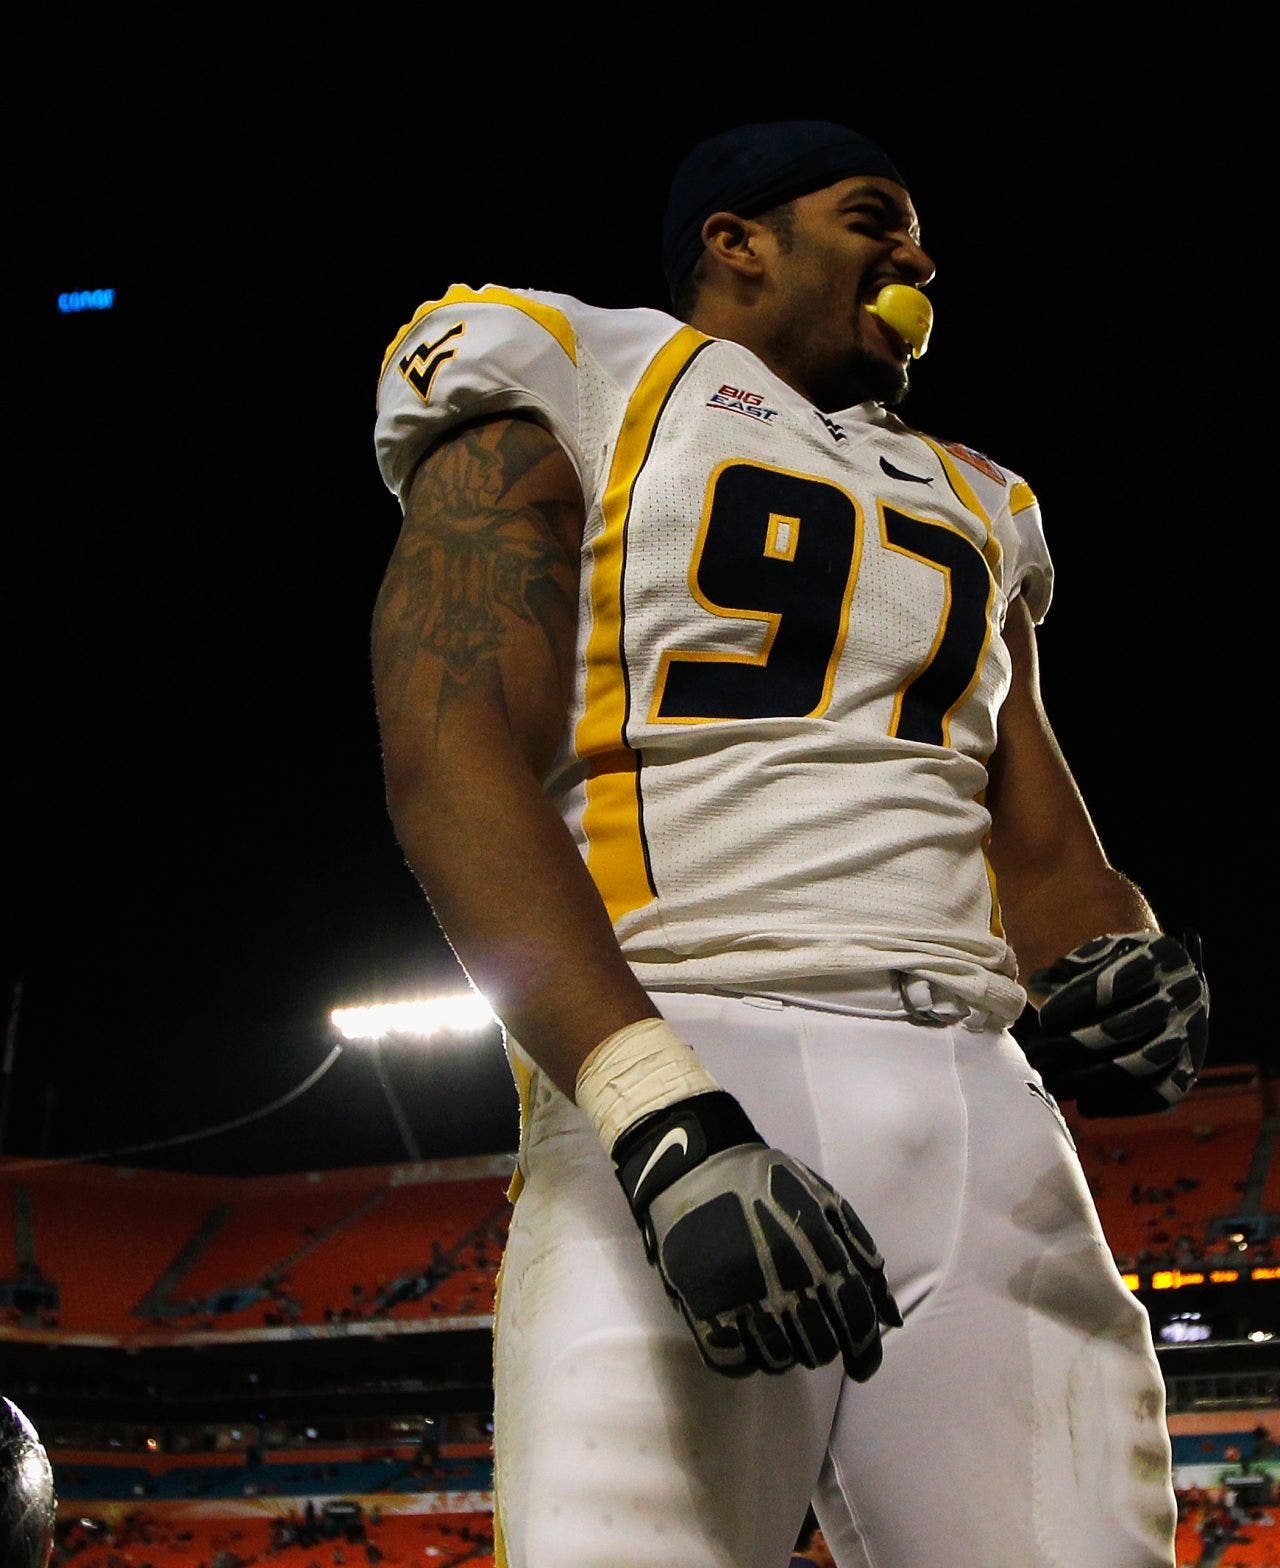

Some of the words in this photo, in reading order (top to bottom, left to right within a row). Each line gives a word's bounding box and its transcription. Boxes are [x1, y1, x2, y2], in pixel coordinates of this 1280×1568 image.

[709, 394, 779, 420] EAST
[718, 384, 765, 406] BIG
[646, 457, 997, 749] 97
